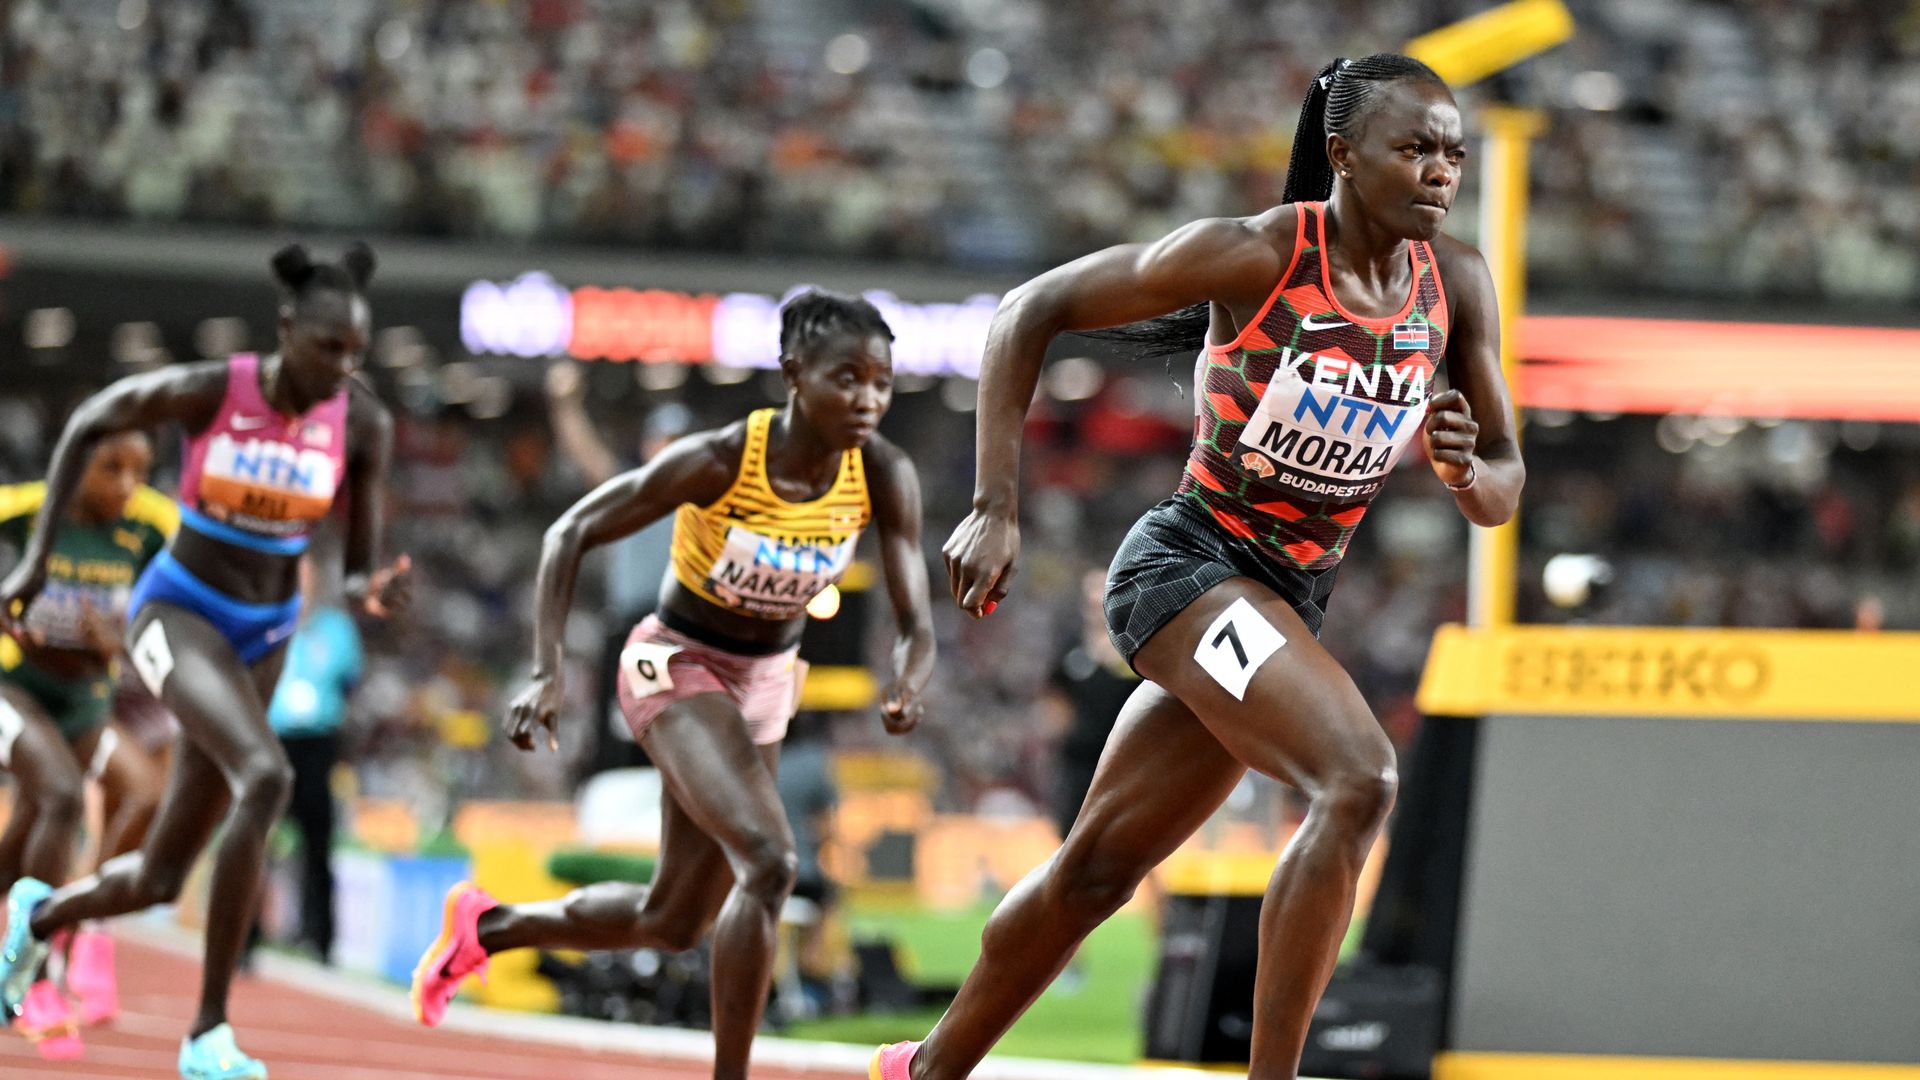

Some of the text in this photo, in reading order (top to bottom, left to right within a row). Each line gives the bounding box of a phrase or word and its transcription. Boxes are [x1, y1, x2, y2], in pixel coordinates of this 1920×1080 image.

[1279, 346, 1426, 403] KENYA
[1293, 387, 1408, 441] NTN
[233, 449, 314, 490] NTN
[1258, 421, 1394, 476] MORAA
[1278, 471, 1362, 498] BUDAPEST
[752, 541, 846, 574] NTN
[1211, 620, 1249, 671] 7
[1503, 644, 1772, 700] SEIKO
